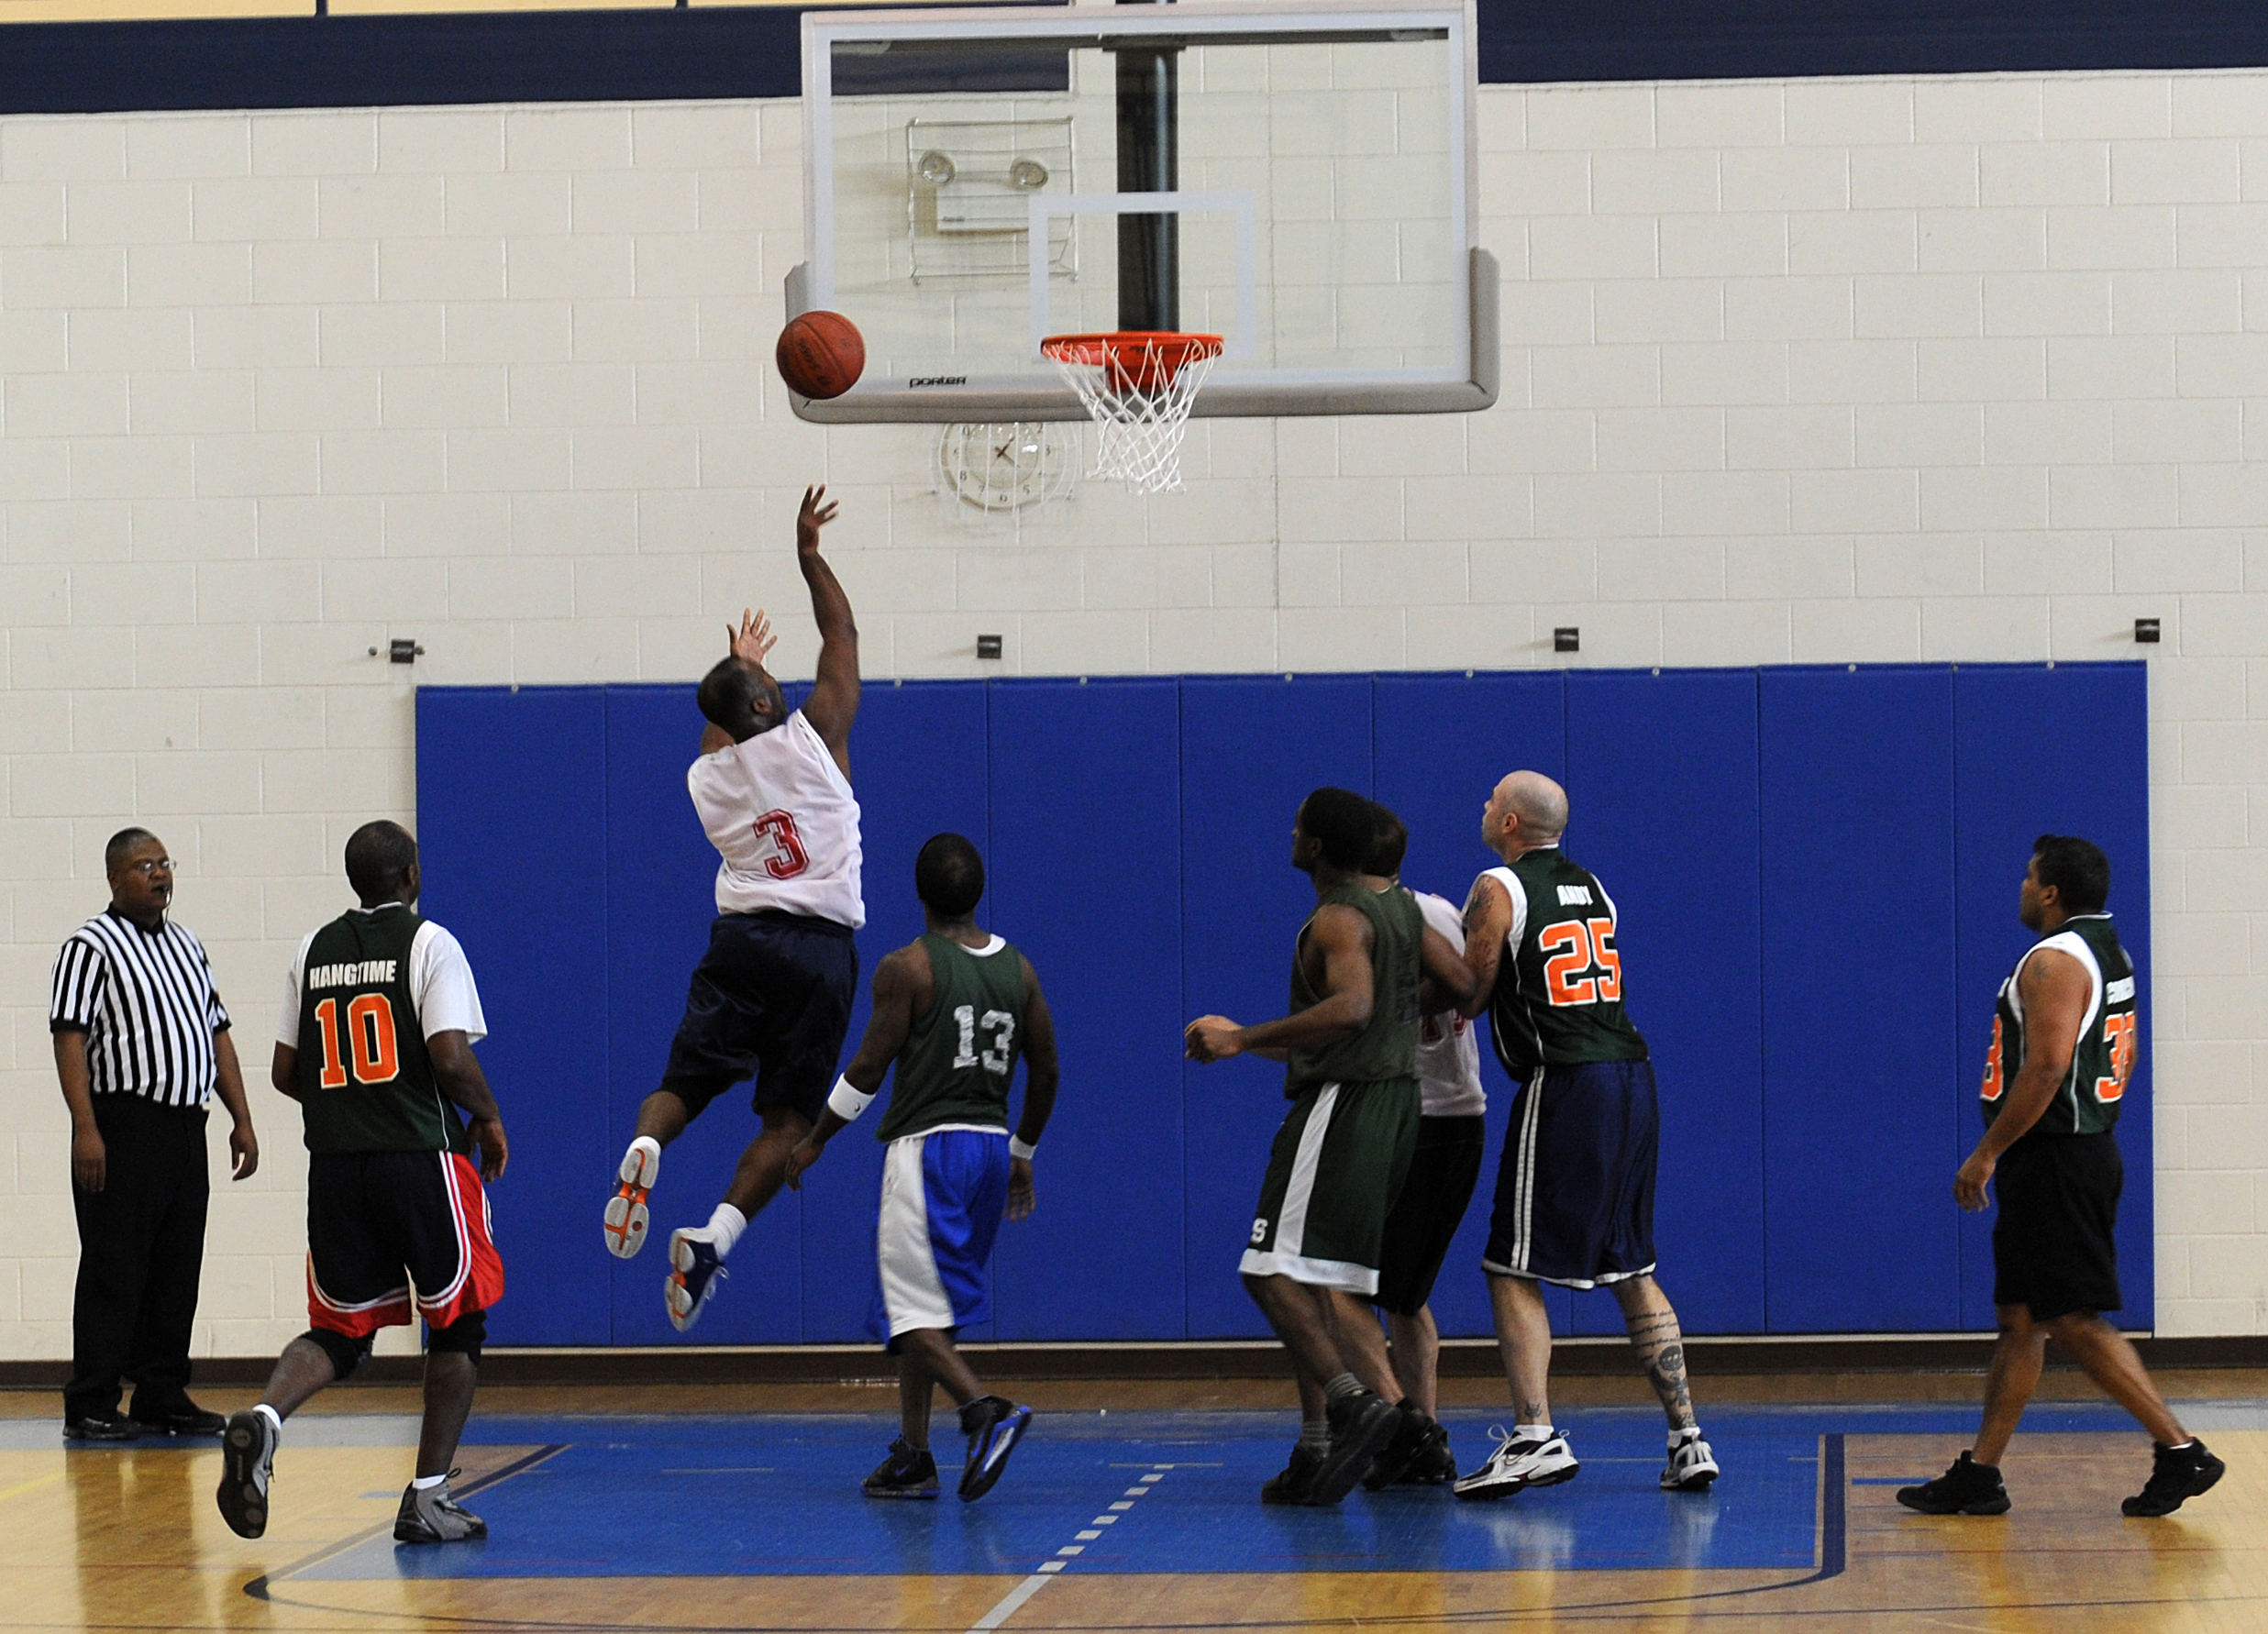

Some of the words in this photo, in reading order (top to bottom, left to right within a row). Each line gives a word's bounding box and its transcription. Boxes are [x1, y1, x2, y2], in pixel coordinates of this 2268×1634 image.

[752, 808, 810, 880] 3
[309, 960, 397, 990] HANGTIME
[1538, 917, 1622, 1007] 25
[315, 992, 400, 1089] 10
[953, 1004, 1015, 1076] 13
